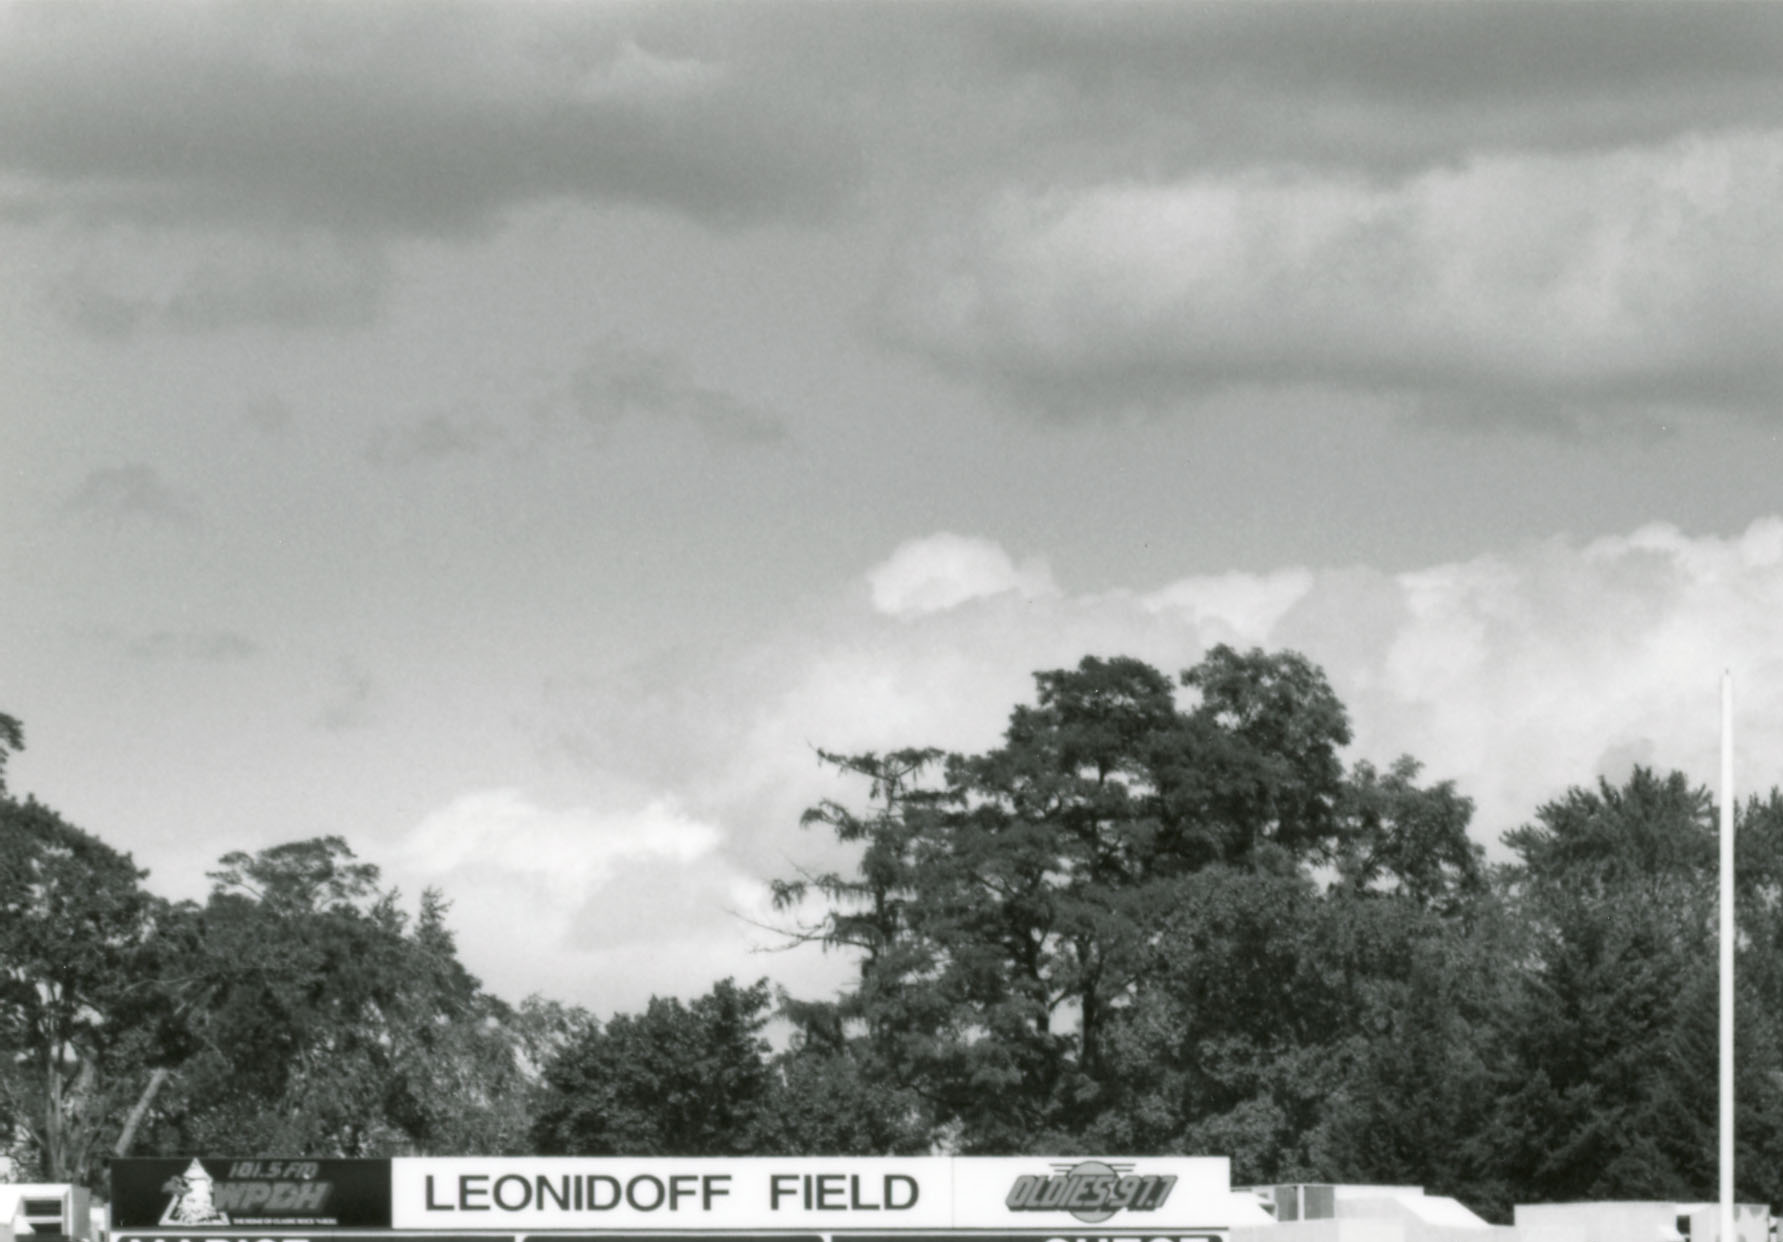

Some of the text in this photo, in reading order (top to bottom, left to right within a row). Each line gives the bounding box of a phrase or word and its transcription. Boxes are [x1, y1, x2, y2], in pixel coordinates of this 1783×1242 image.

[427, 1174, 919, 1211] LEONIDOFF FIELD
[1006, 1175, 1114, 1211] OLDIES
